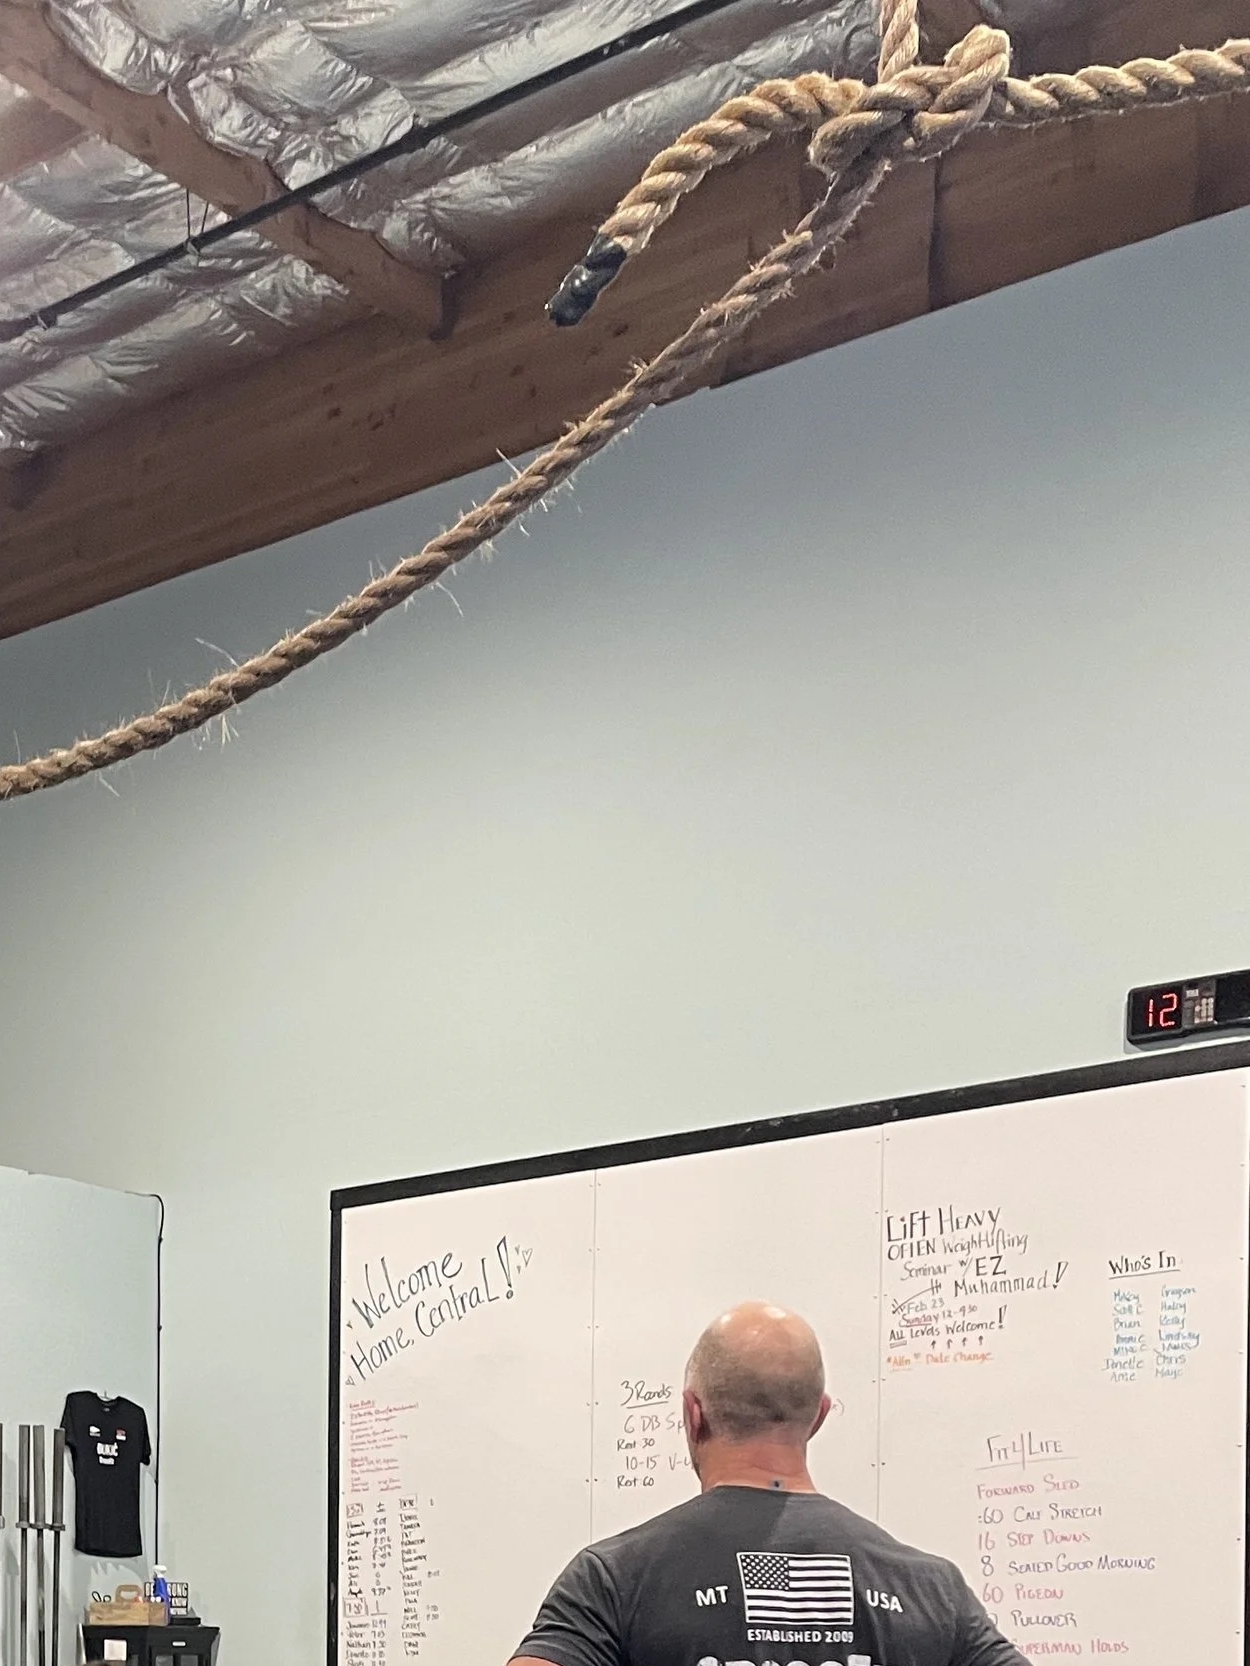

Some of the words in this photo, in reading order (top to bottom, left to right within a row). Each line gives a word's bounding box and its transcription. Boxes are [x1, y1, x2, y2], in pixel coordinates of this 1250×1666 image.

[1148, 993, 1178, 1027] 12
[938, 1205, 1001, 1236] HEAVY
[975, 1255, 1007, 1276] EZ
[1109, 1255, 1152, 1275] Who's
[1158, 1250, 1177, 1269] In
[352, 1252, 463, 1329] Welcome
[350, 1327, 415, 1381] Home,
[620, 1380, 634, 1406] 3
[635, 1380, 672, 1401] Rounds
[640, 1415, 661, 1432] DB
[642, 1437, 655, 1449] 30
[626, 1454, 660, 1471] 10-15
[642, 1475, 655, 1487] 60
[976, 1483, 1035, 1499] FORWARD
[1043, 1473, 1079, 1494] SLED
[1049, 1502, 1102, 1520] STRETCH
[978, 1531, 996, 1551] 16
[1007, 1531, 1034, 1548] STEP
[1043, 1528, 1091, 1546] DOWNS
[980, 1555, 995, 1577] 8
[1056, 1552, 1093, 1573] GOOD
[1097, 1554, 1156, 1571] MORNING
[695, 1585, 729, 1607] MT
[865, 1588, 903, 1613] USA
[1015, 1582, 1064, 1601] PIGEON
[1011, 1609, 1078, 1628] PULLOVER
[747, 1628, 822, 1643] ESTABLISHED
[1091, 1638, 1130, 1654] HOLDS
